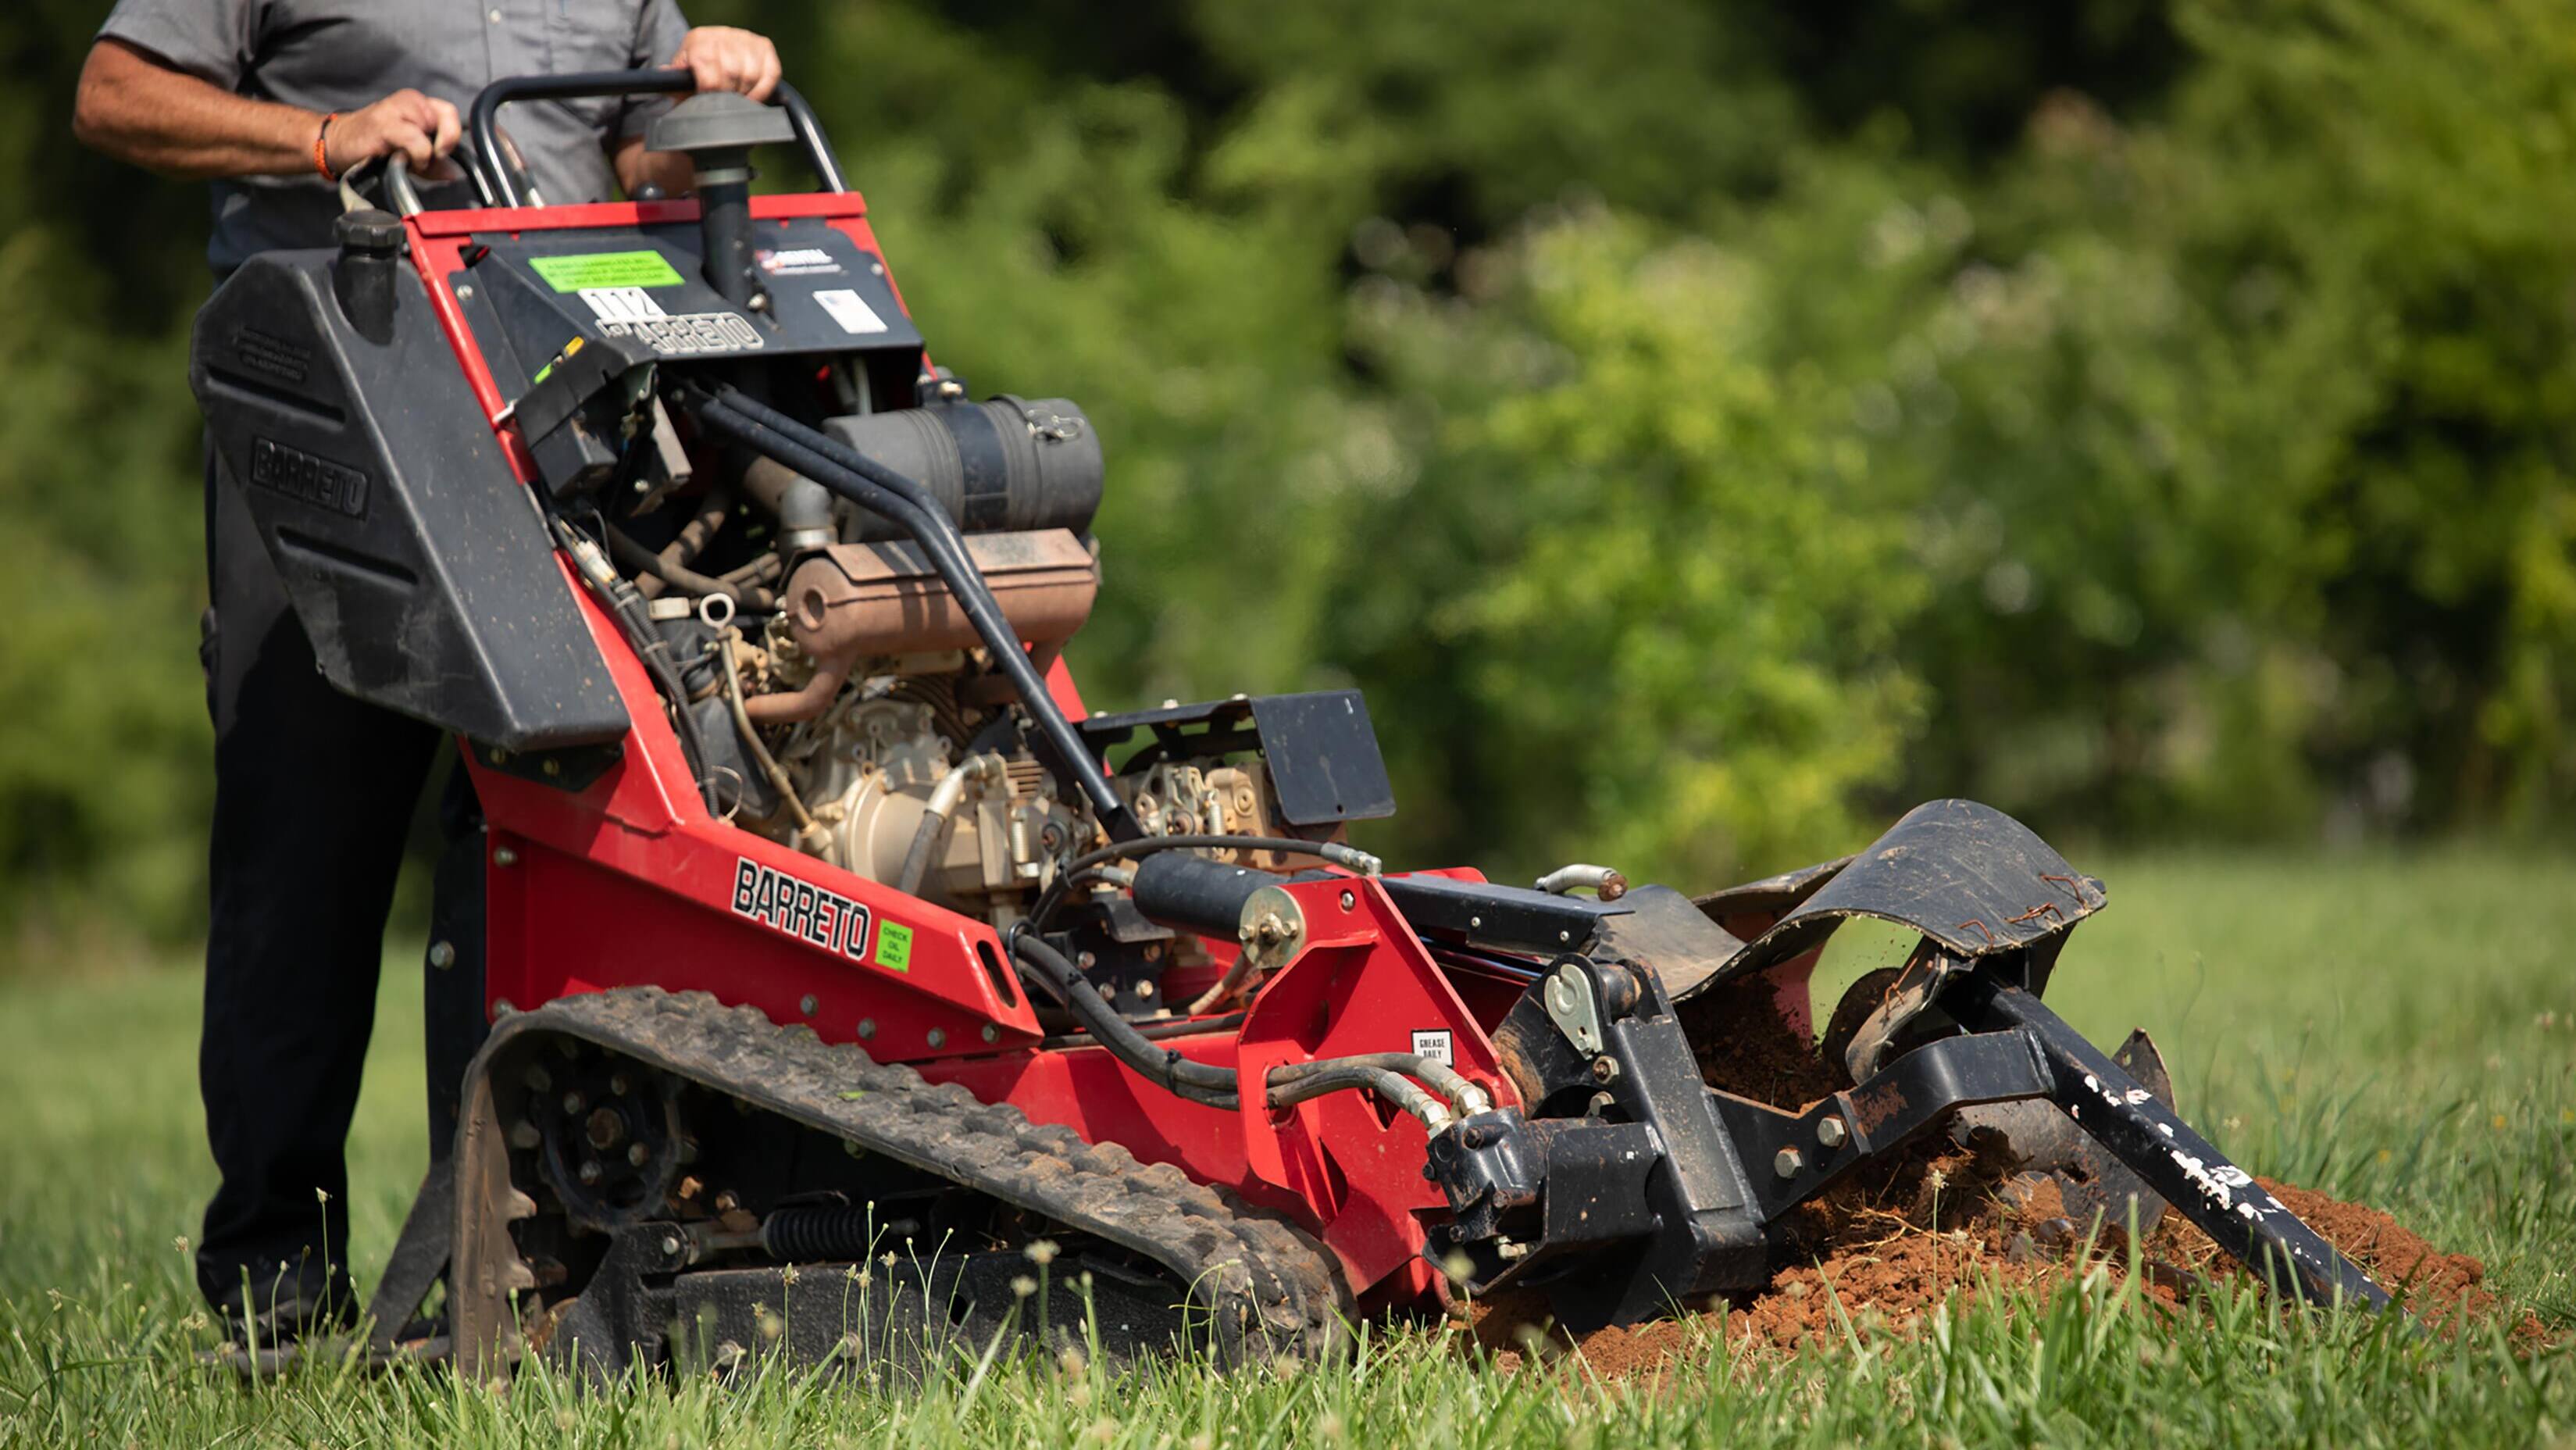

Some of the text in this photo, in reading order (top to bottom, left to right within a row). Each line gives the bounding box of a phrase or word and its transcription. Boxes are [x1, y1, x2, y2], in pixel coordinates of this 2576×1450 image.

[590, 288, 659, 317] 112
[254, 438, 367, 516] BARRETO
[732, 855, 872, 961] BARRETO
[883, 927, 908, 942] CHECK
[887, 940, 900, 952] OIL
[883, 950, 902, 962] DAILY
[1419, 1039, 1445, 1048] GREASE
